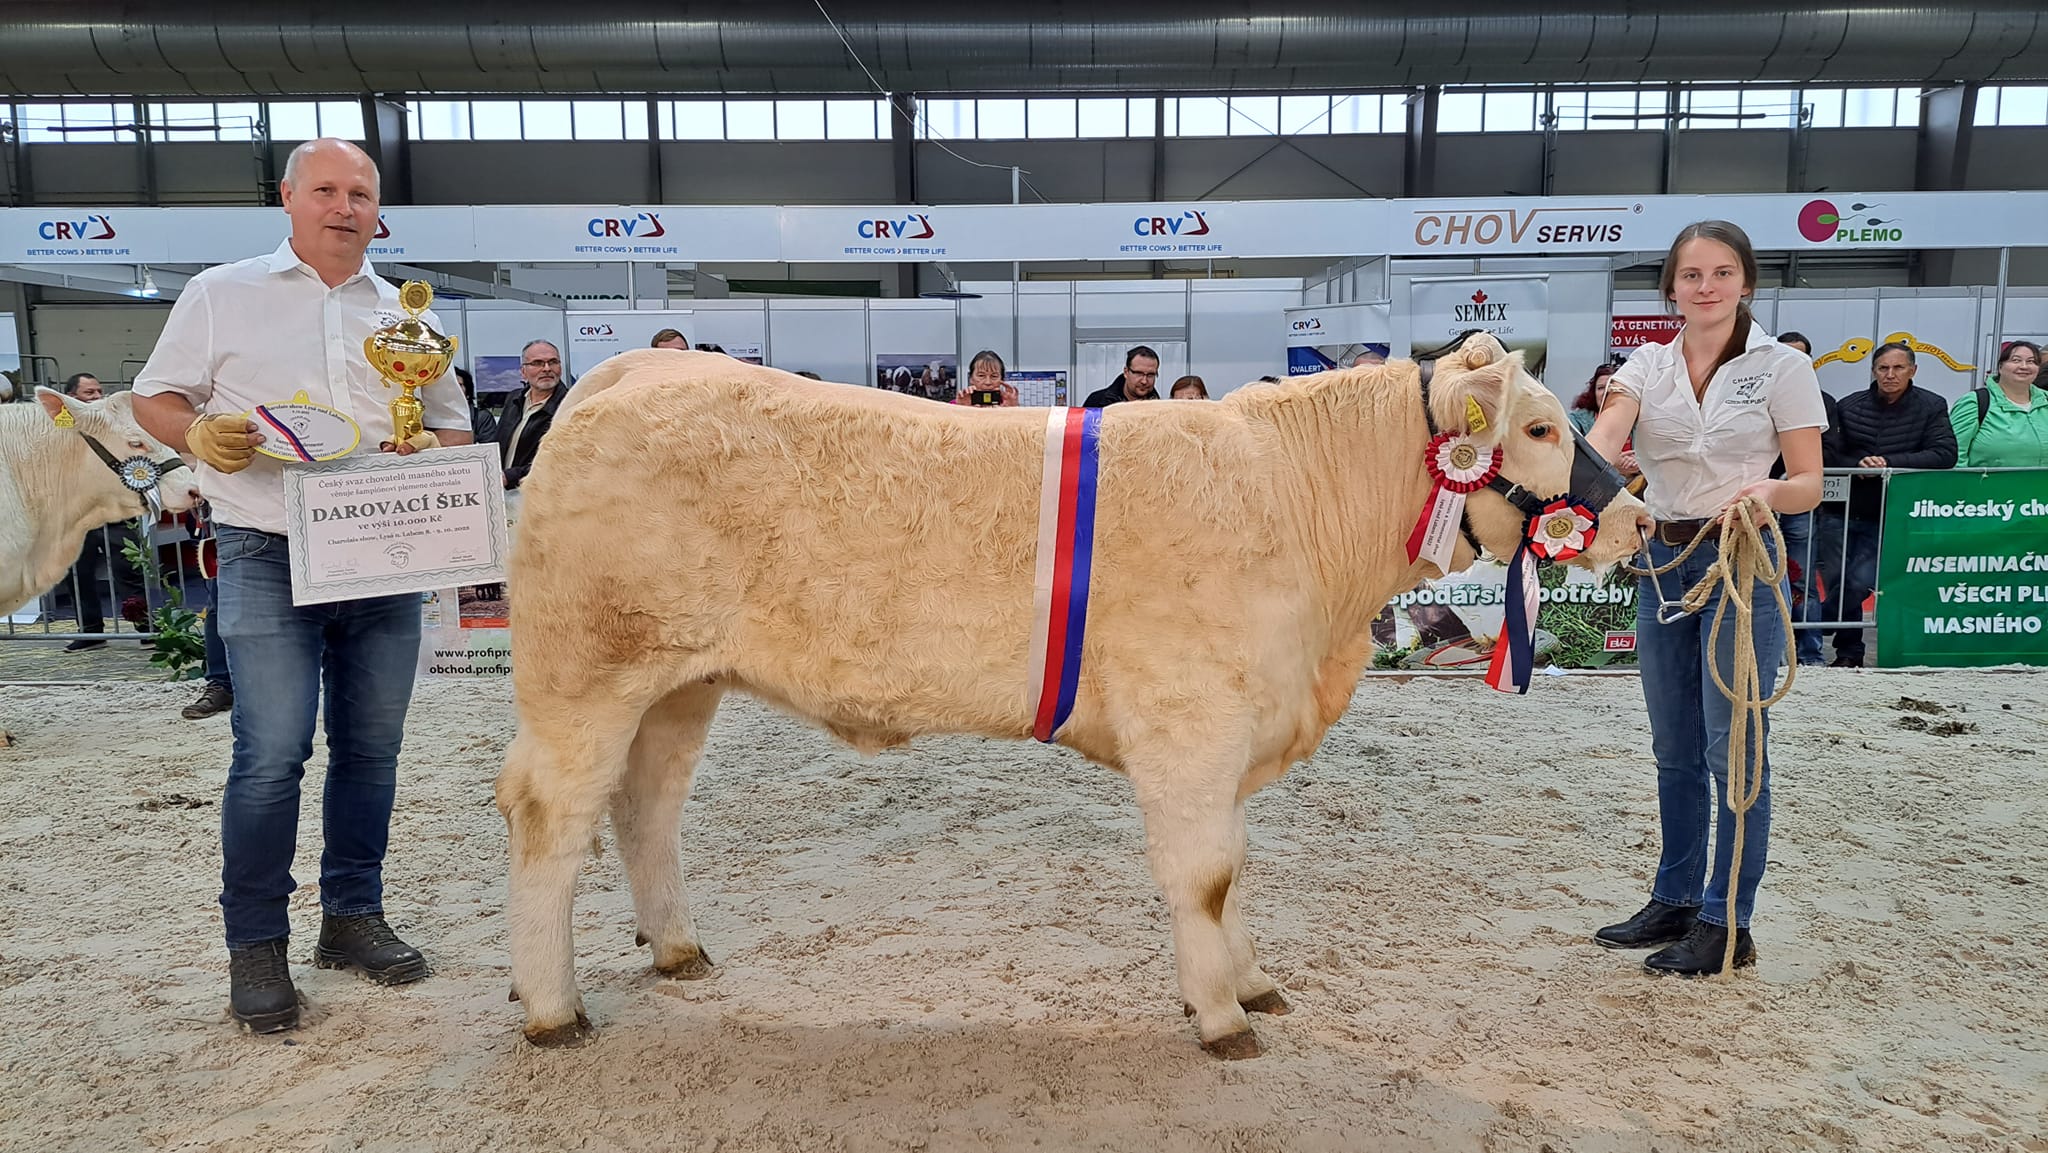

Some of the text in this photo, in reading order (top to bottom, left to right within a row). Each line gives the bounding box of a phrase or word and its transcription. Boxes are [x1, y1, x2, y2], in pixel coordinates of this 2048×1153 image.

[38, 221, 88, 240] CRV
[587, 218, 637, 237] CRV
[858, 220, 907, 239] CRV
[1134, 217, 1183, 236] CRV
[1414, 209, 1538, 246] CHOV
[1536, 223, 1624, 244] SERVIS
[1836, 228, 1903, 242] PLEMO
[575, 245, 602, 253] BETTER
[873, 247, 896, 255] COWS
[1120, 244, 1222, 252] BETTER COWS BETTER LIFE
[1454, 303, 1508, 322] SEMEX
[579, 326, 601, 336] CRV
[1292, 320, 1311, 331] CRV
[1498, 326, 1514, 335] Life
[1628, 320, 1682, 331] GENETIKA
[1624, 334, 1647, 346] VÁS
[1290, 364, 1322, 374] OVALERT
[318, 467, 471, 489] Český svaz chovatelů masného skotu
[398, 483, 428, 493] plemene
[429, 479, 461, 489] charolais
[311, 491, 481, 523] DAROVACÍ ŠEK
[1908, 499, 2016, 522] Jihočeský
[371, 519, 391, 531] výši
[393, 517, 427, 527] 10.000
[429, 514, 443, 523] Kč
[1906, 551, 2048, 573] INSEMINAČN
[1937, 582, 2048, 603] VŠECH PL
[1923, 612, 2042, 634] MASNÉHO
[429, 664, 513, 676] obchod.profip
